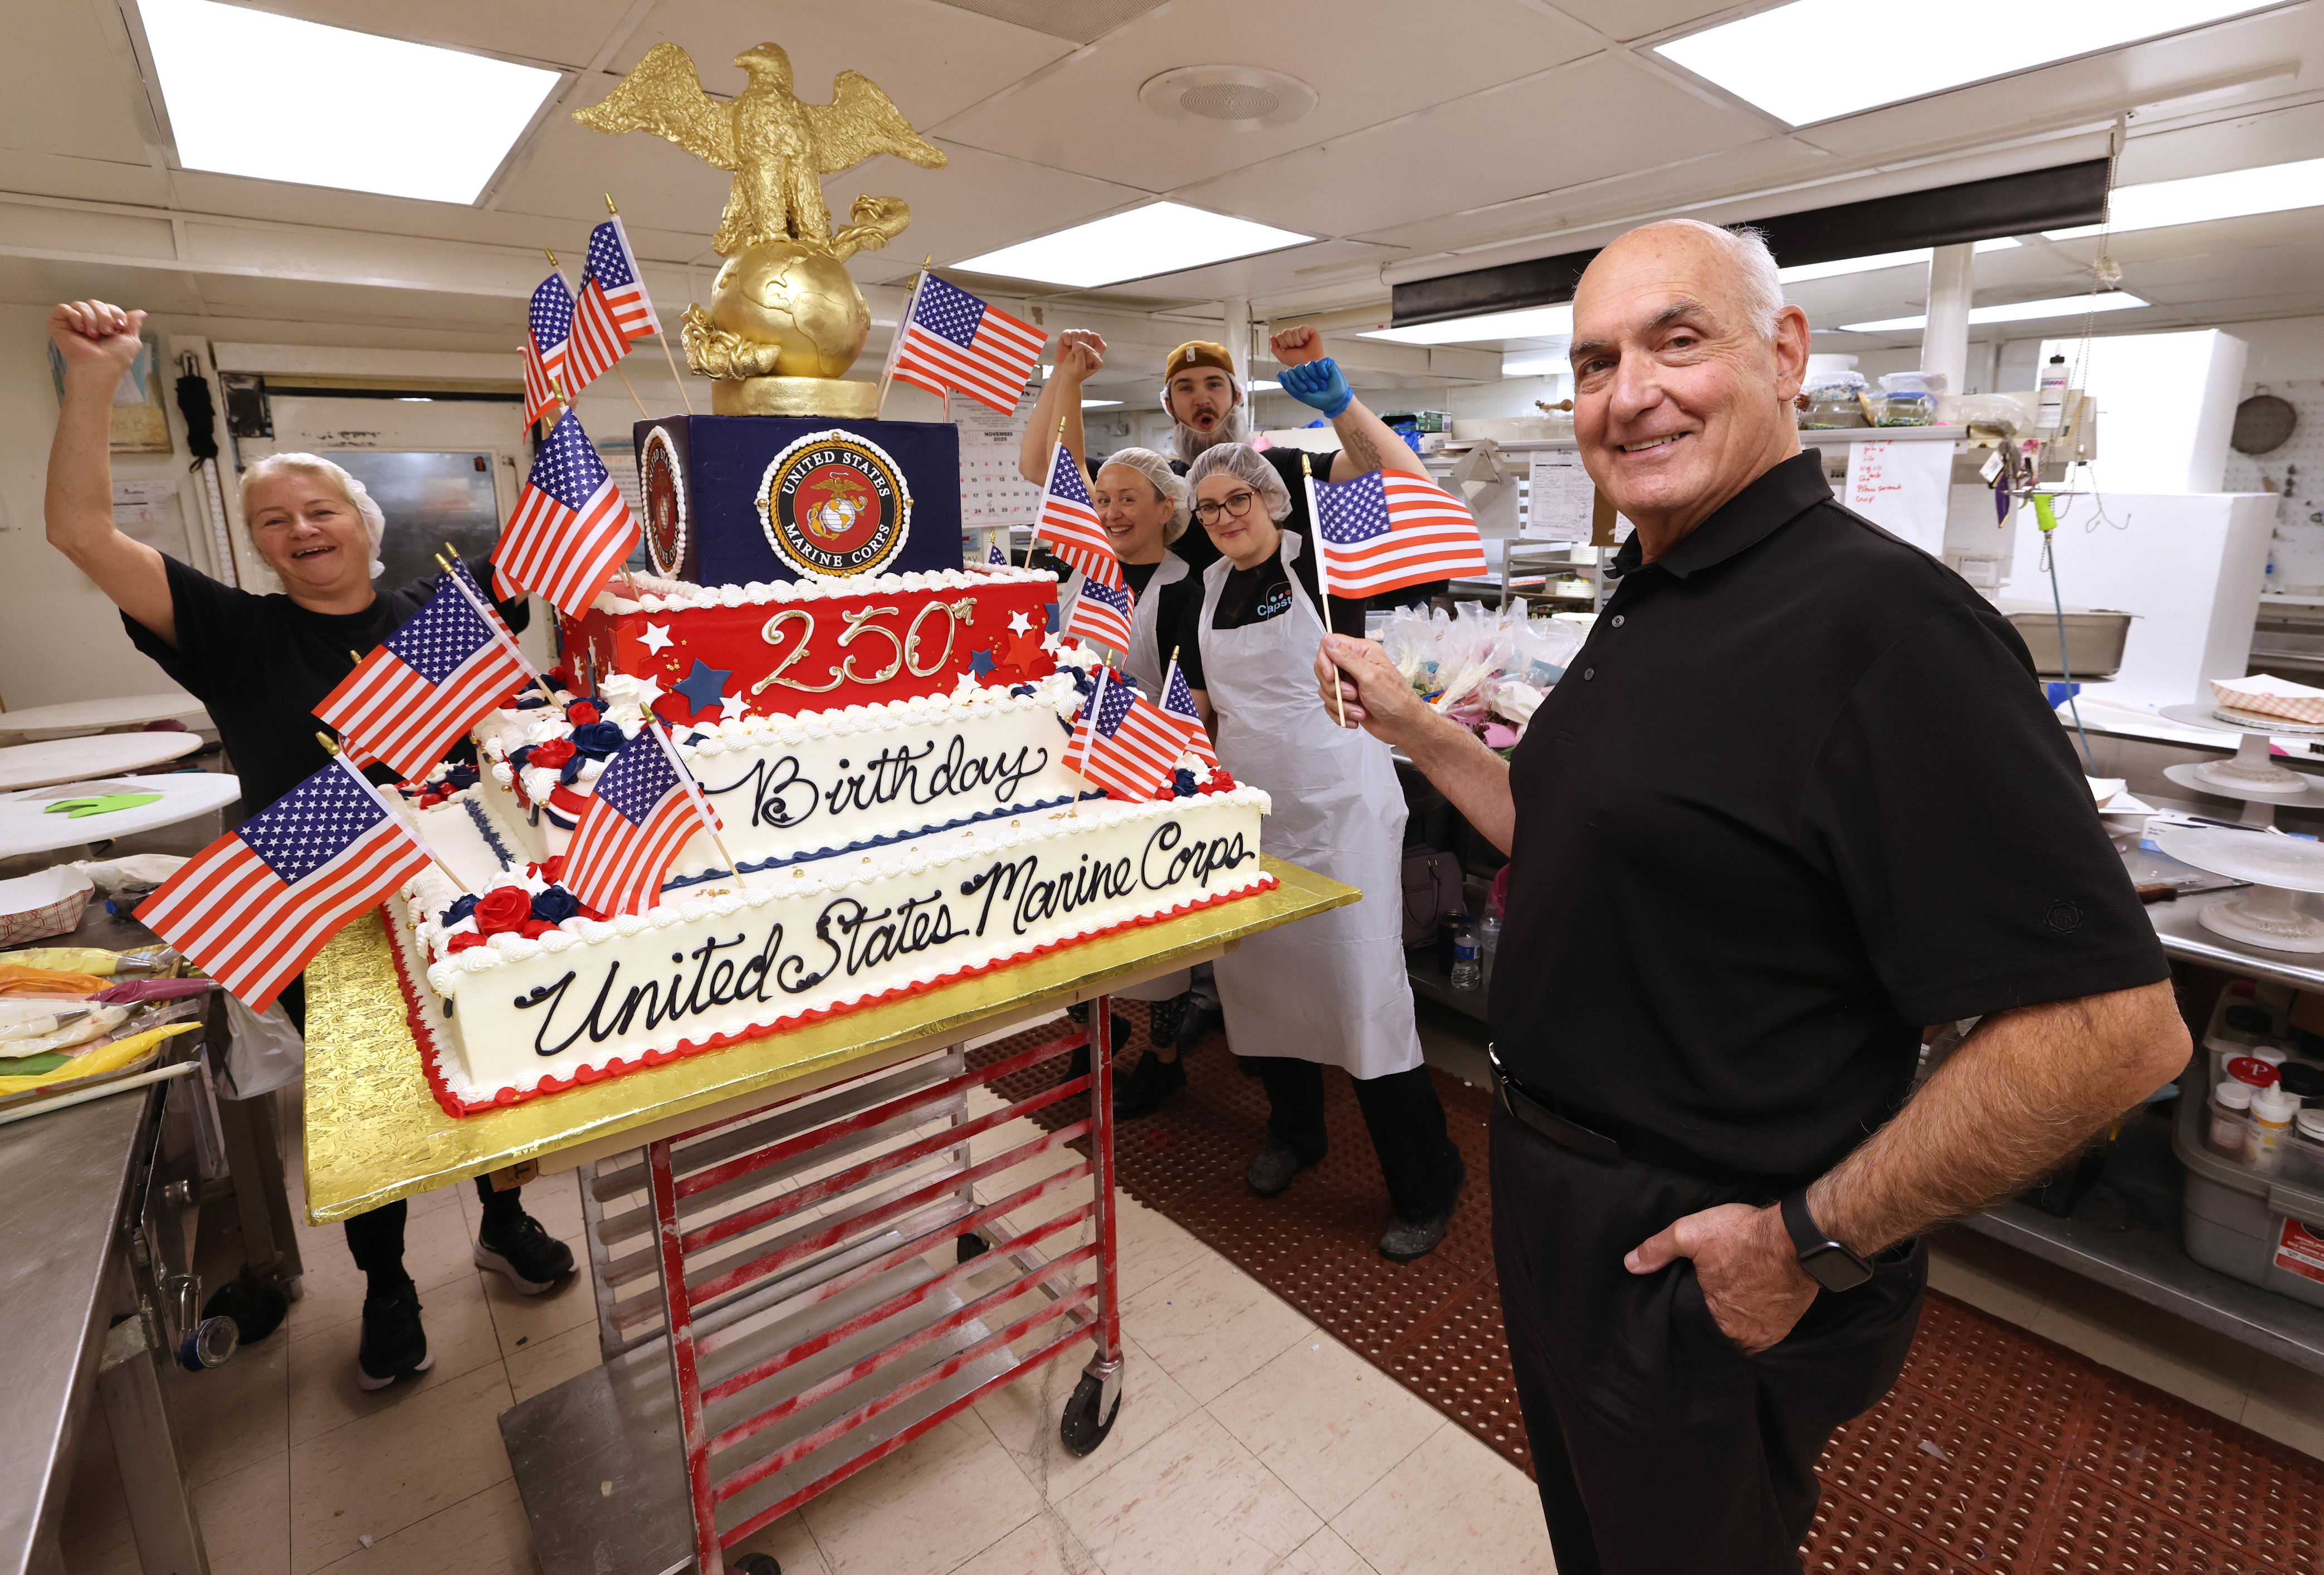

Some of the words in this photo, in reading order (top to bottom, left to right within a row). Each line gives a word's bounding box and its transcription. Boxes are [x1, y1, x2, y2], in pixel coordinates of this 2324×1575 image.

[782, 451, 835, 495] UNITED
[843, 452, 890, 497] STATES
[784, 522, 842, 567] MARINE
[852, 524, 890, 563] CORPS
[699, 734, 1047, 828] Birthday
[514, 923, 782, 1056] United
[778, 890, 969, 993] States
[960, 854, 1136, 937] Marine
[1141, 821, 1255, 890] Corps
